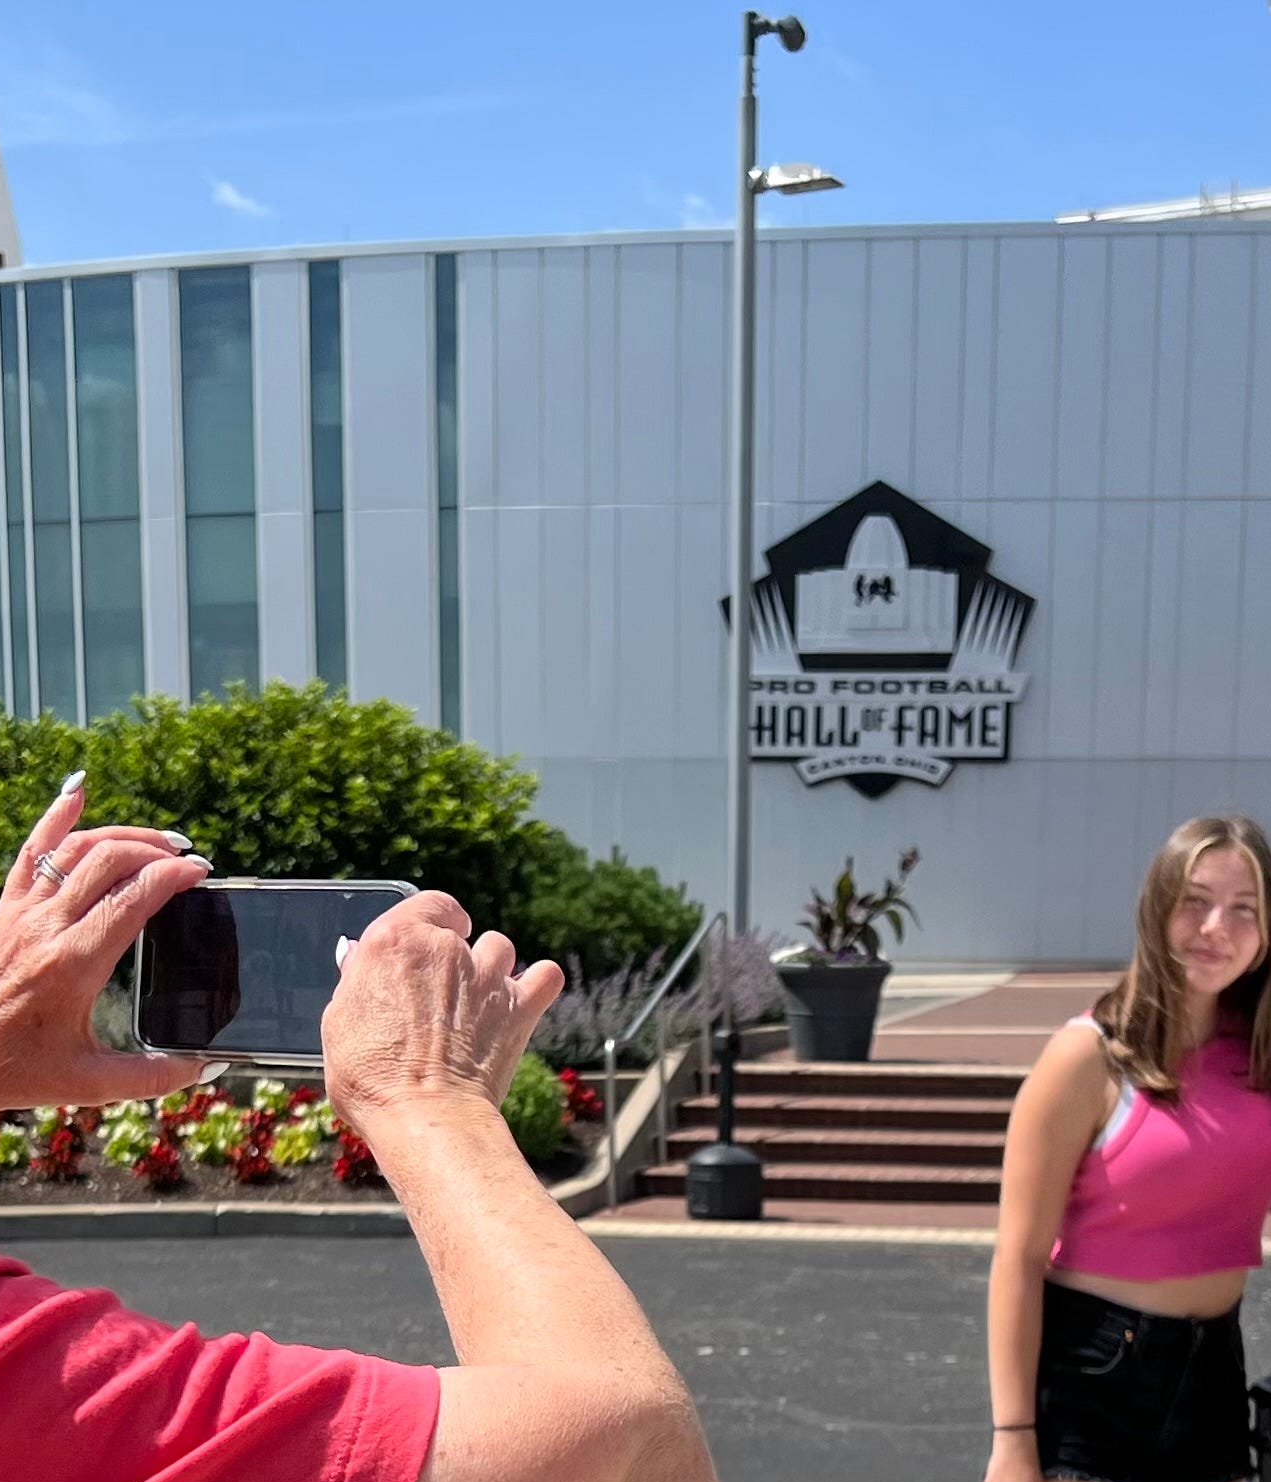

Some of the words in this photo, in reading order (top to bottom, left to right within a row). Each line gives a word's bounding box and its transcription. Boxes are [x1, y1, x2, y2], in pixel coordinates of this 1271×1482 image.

[830, 680, 1015, 694] FOOTBALL
[749, 704, 859, 747] HALL
[861, 708, 887, 731] OF
[890, 704, 1000, 747] FAME
